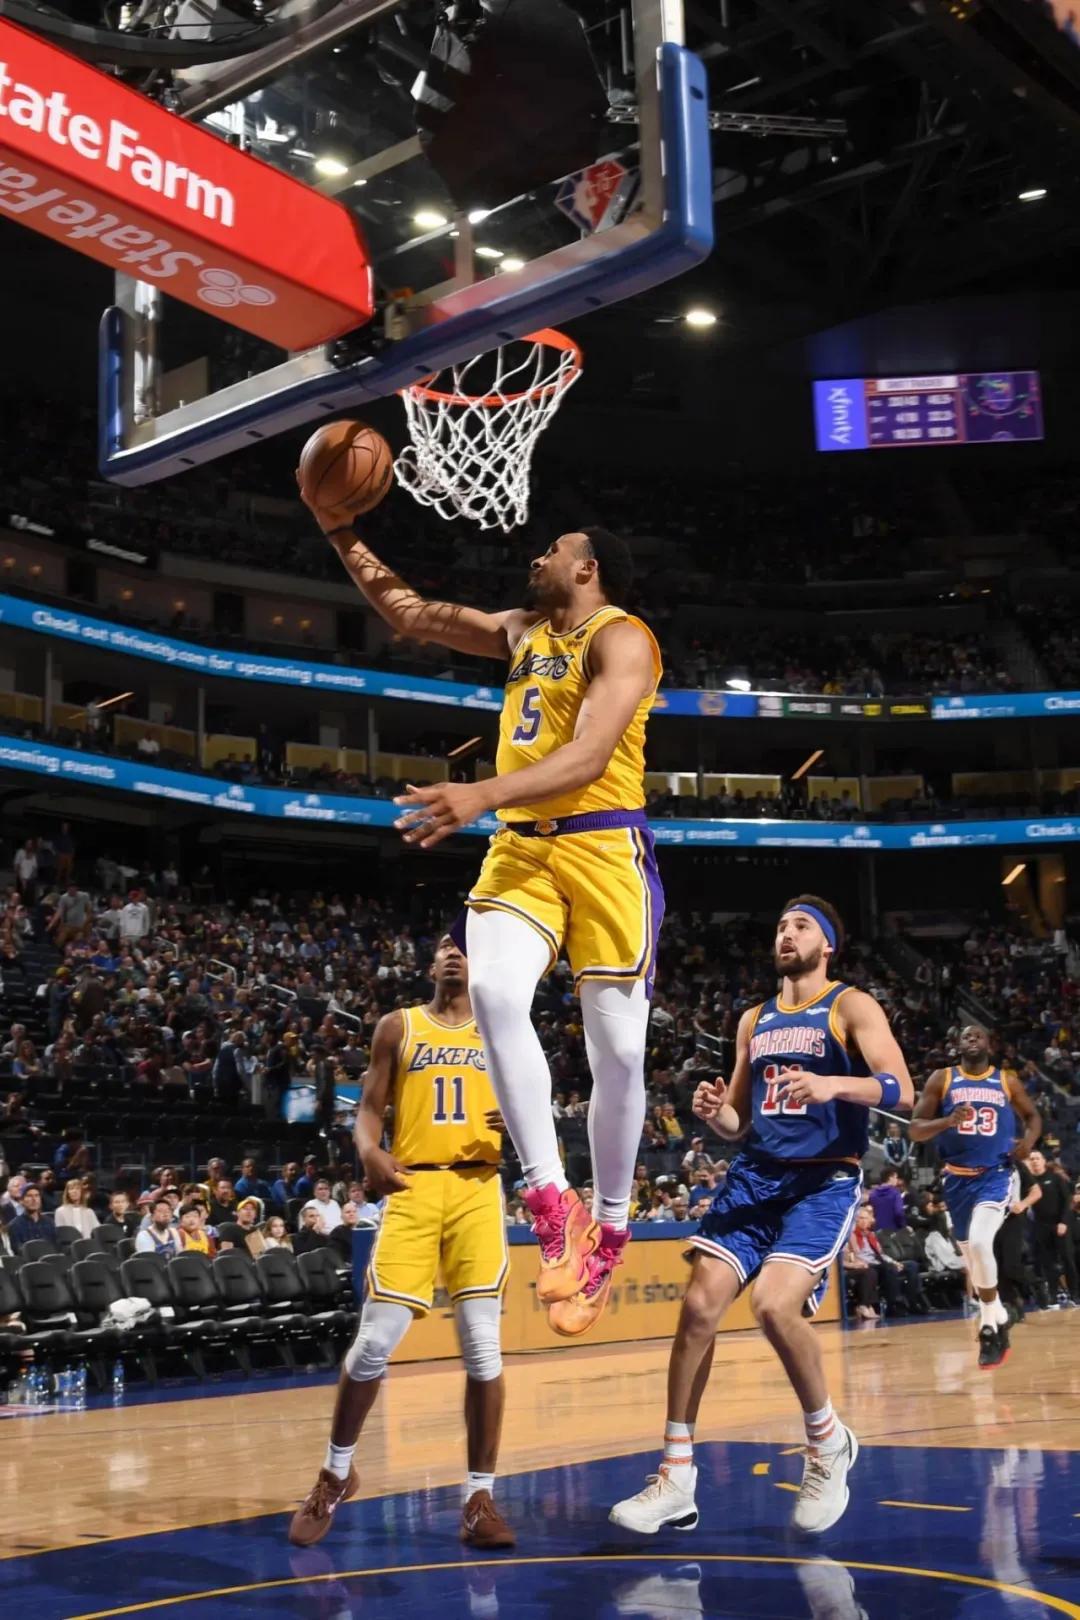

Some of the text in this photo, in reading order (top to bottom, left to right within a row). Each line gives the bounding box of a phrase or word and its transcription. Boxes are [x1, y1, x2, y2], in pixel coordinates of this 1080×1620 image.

[106, 119, 235, 227] Farm
[0, 162, 204, 278] State Fa
[512, 687, 542, 745] 5
[750, 1026, 826, 1063] WARRIORS
[432, 1076, 467, 1125] 11
[951, 1087, 1005, 1107] WARRIORS
[958, 1106, 998, 1136] 23
